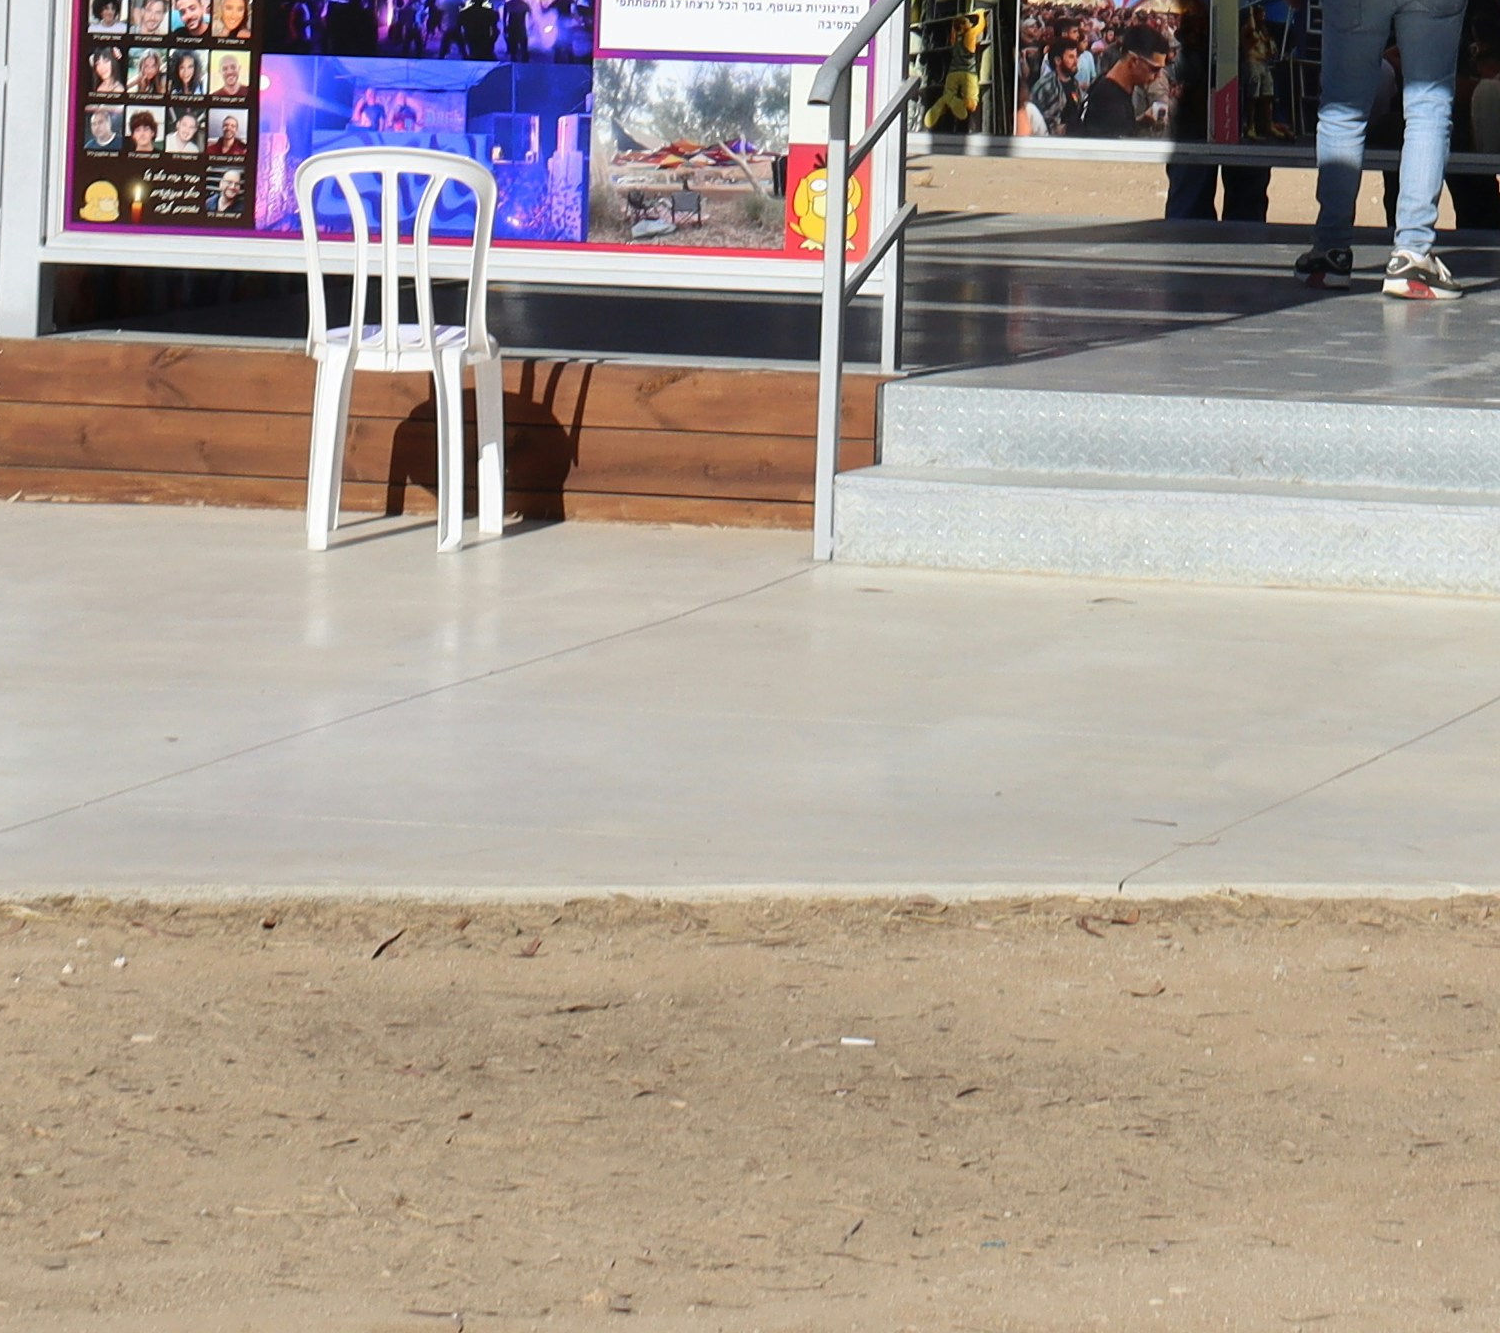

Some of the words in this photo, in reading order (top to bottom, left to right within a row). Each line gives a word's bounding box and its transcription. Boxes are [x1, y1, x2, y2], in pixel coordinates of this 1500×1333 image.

[670, 0, 681, 8] 17
[685, 0, 714, 9] נרצחו
[718, 0, 738, 10] הכל
[742, 2, 761, 11] בסך
[805, 3, 859, 13] ובמיגוניות
